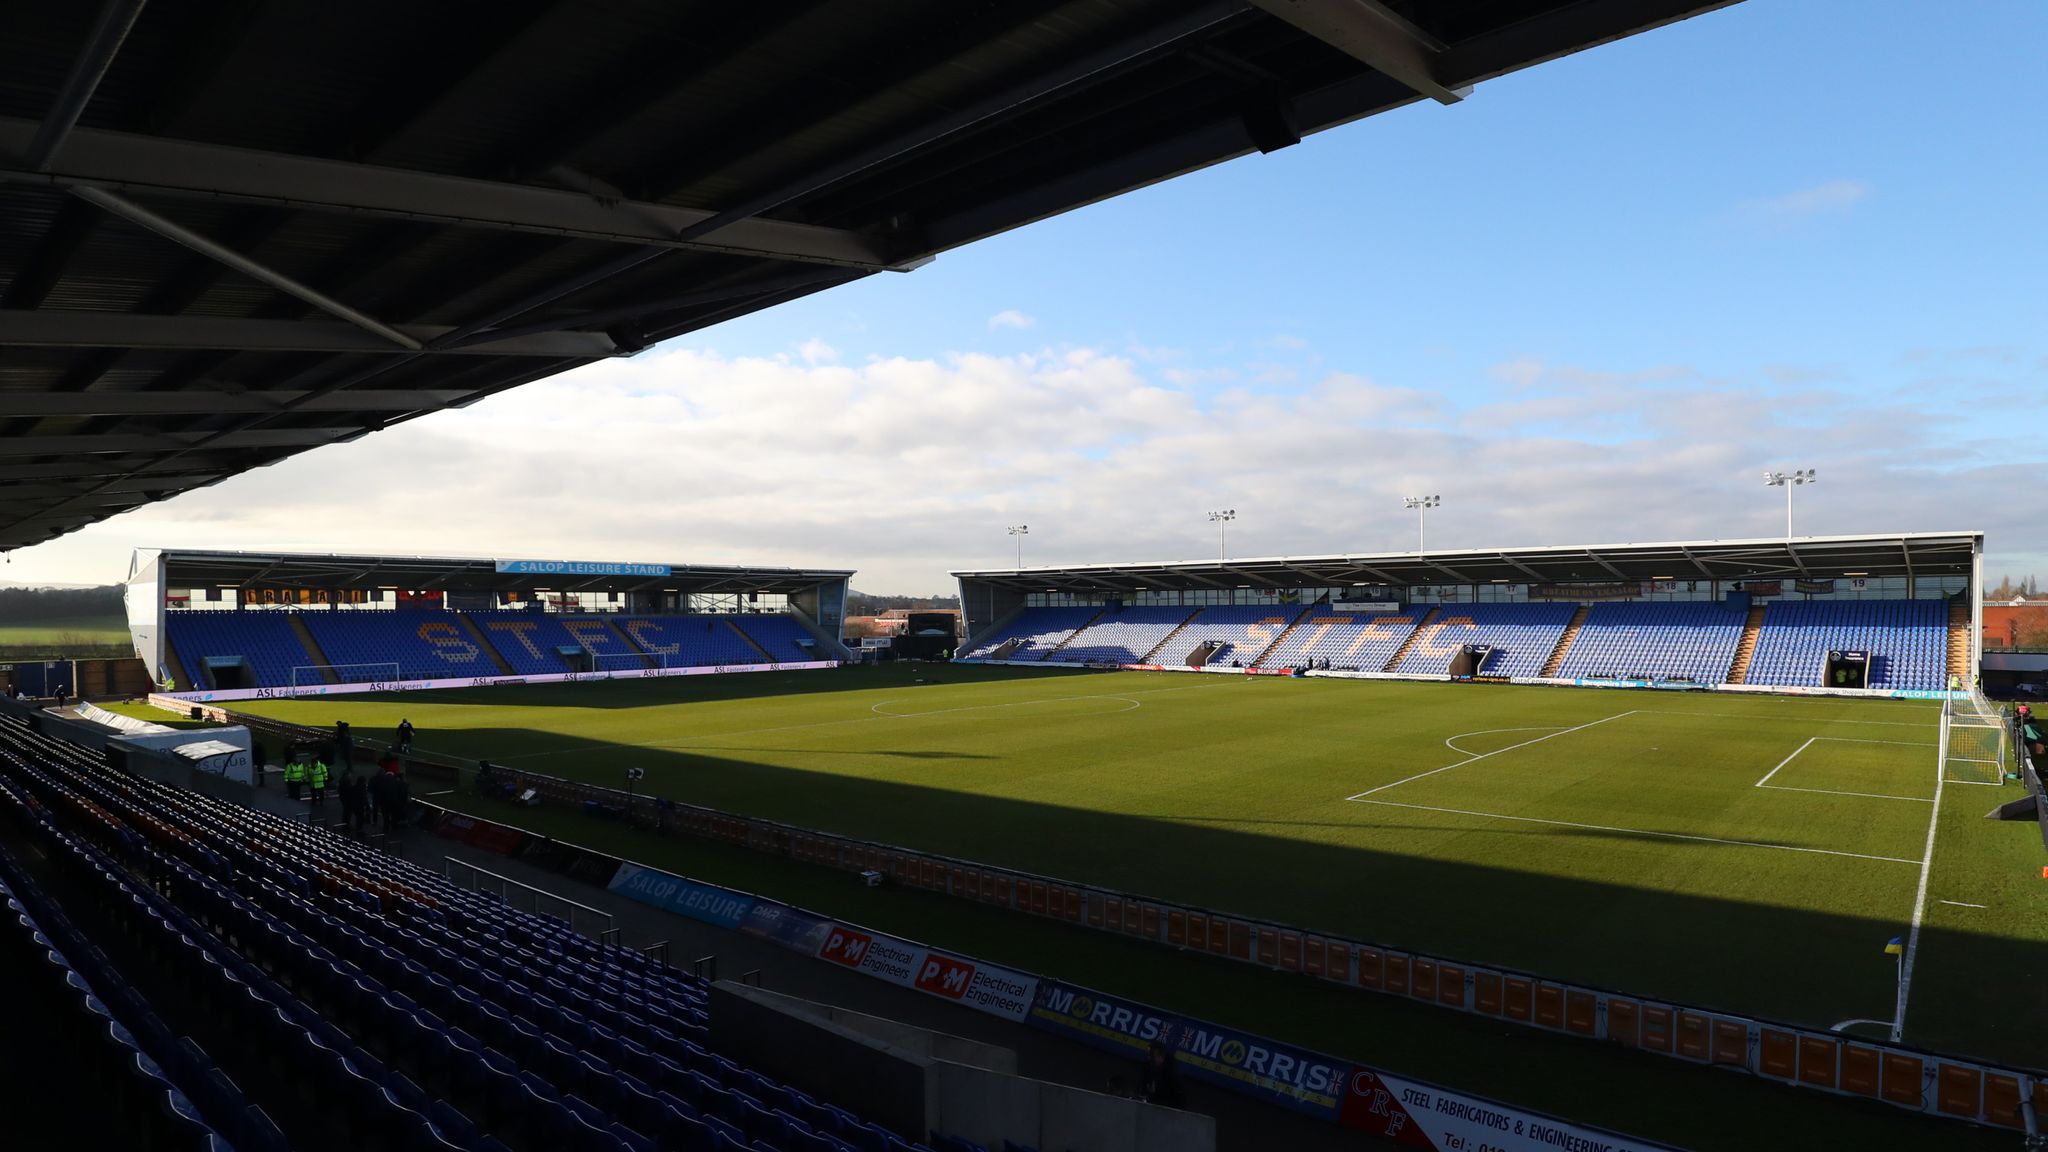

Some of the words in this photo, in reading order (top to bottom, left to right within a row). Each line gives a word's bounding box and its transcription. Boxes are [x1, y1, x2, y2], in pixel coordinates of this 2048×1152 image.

[520, 562, 564, 572] SALOP
[568, 563, 621, 573] LEISURE
[625, 564, 665, 574] STAND
[1666, 582, 1676, 590] 18
[1852, 579, 1864, 587] 19
[417, 621, 680, 663] STFC
[643, 669, 655, 677] ASL
[714, 666, 725, 674] ASL
[256, 688, 276, 698] ASL
[279, 688, 318, 697] Fasteners
[369, 682, 385, 692] ASL
[628, 873, 678, 900] SALOP
[677, 887, 748, 921] LEISURE
[752, 905, 781, 920] DMR
[869, 941, 914, 965] Electrical
[862, 955, 910, 979] Engineers
[973, 971, 1027, 997] Electrical
[966, 985, 1025, 1014] Engineers
[1047, 987, 1162, 1040] MORRIS
[1191, 1030, 1331, 1091] MORRIS
[1352, 1071, 1407, 1136] CRF
[1401, 1088, 1430, 1109] STEEL
[1436, 1098, 1511, 1132] FABRICATORS
[1514, 1120, 1524, 1135] &
